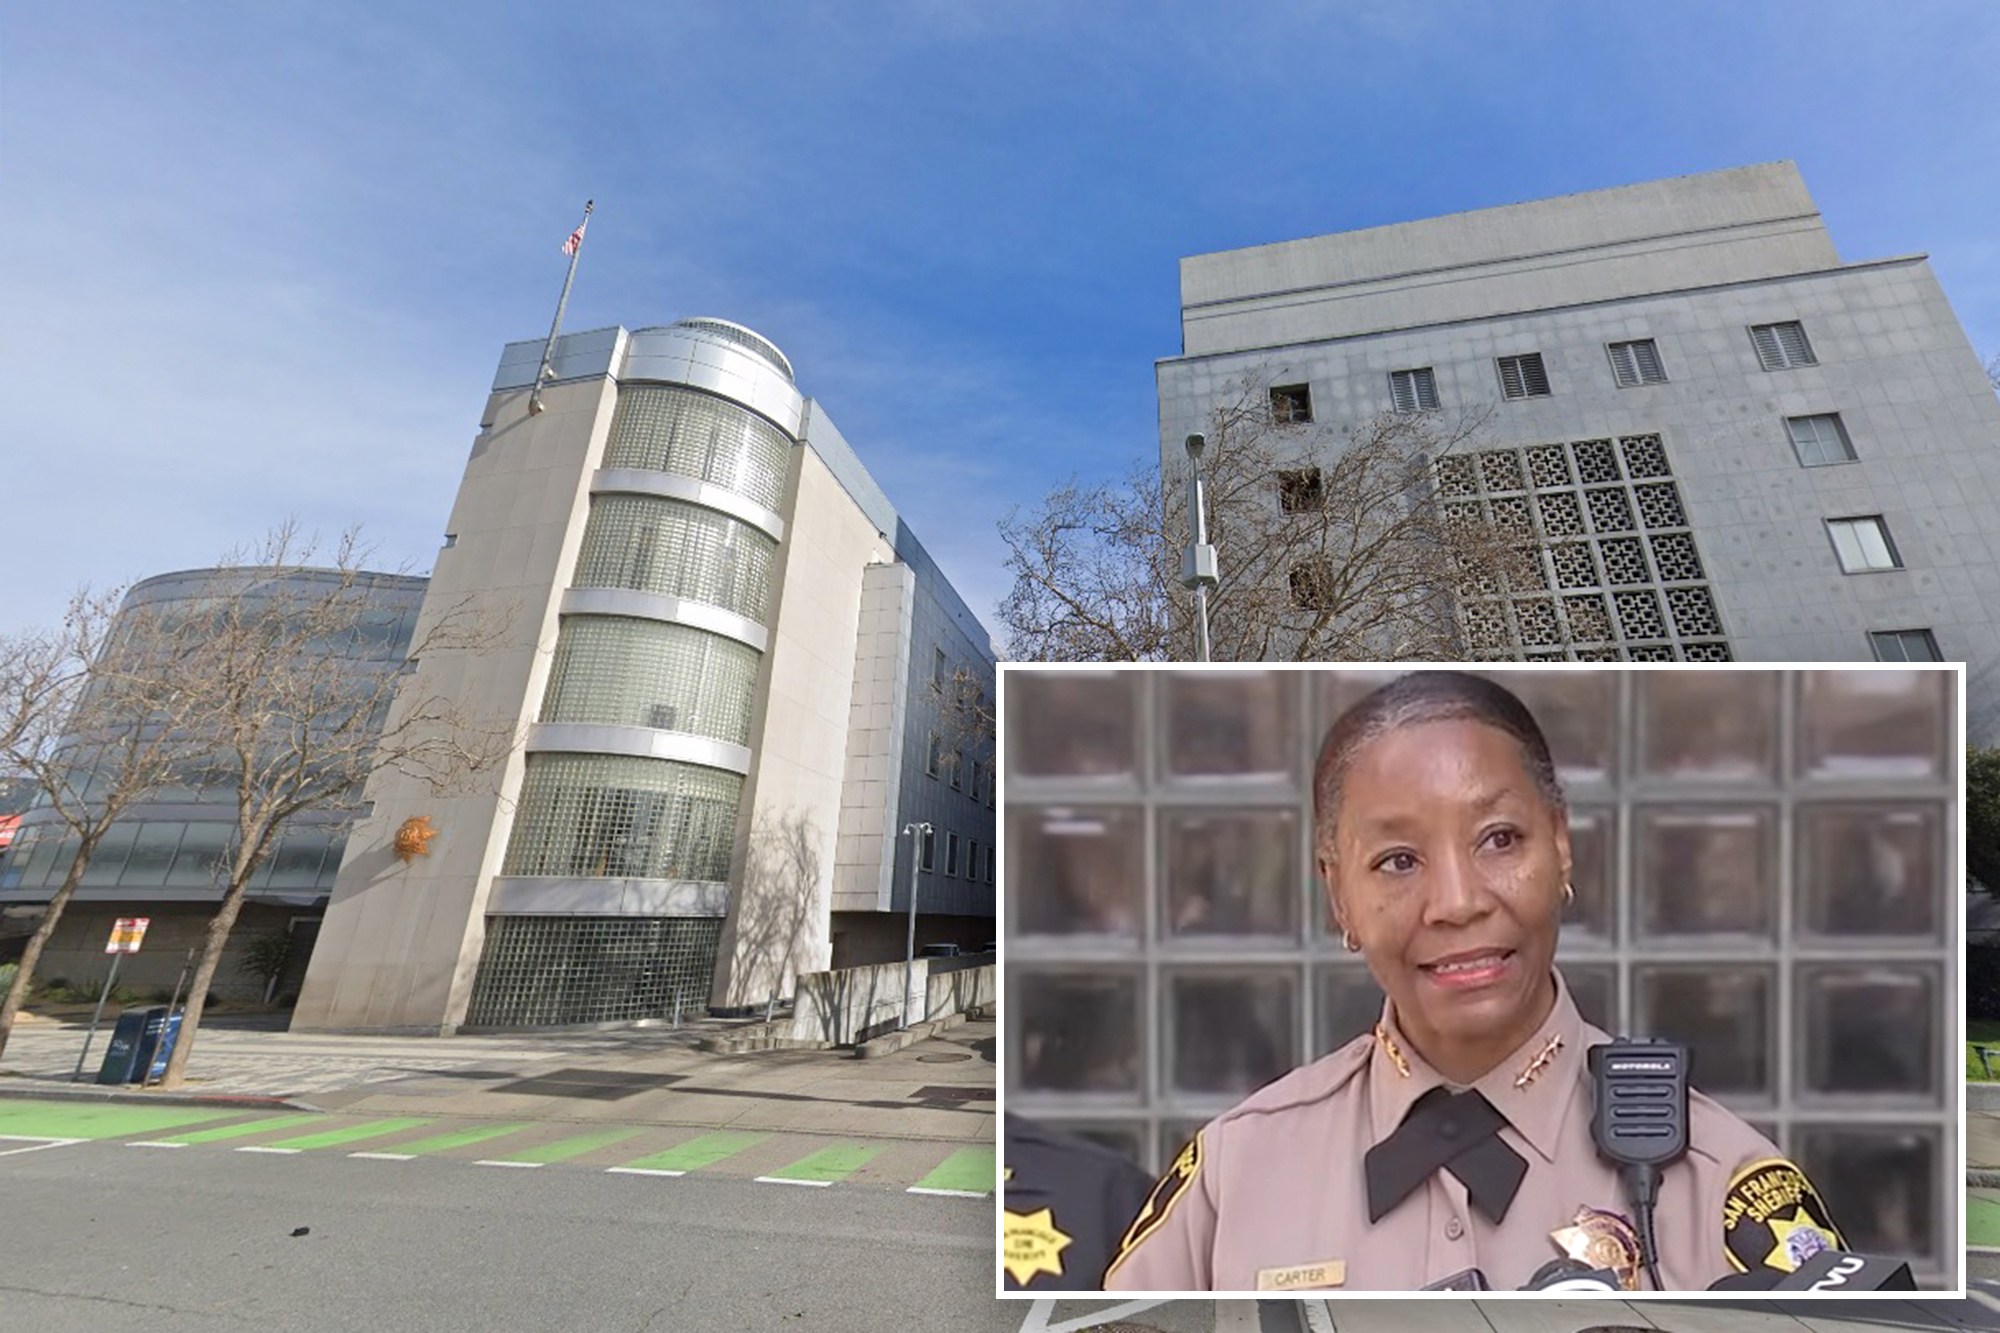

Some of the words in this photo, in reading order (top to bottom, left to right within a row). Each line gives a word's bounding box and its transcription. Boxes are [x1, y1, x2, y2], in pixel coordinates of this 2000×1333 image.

[1611, 1062, 1670, 1070] MOTOROLA
[1723, 1196, 1748, 1230] SAN
[1274, 1267, 1327, 1287] CARTER
